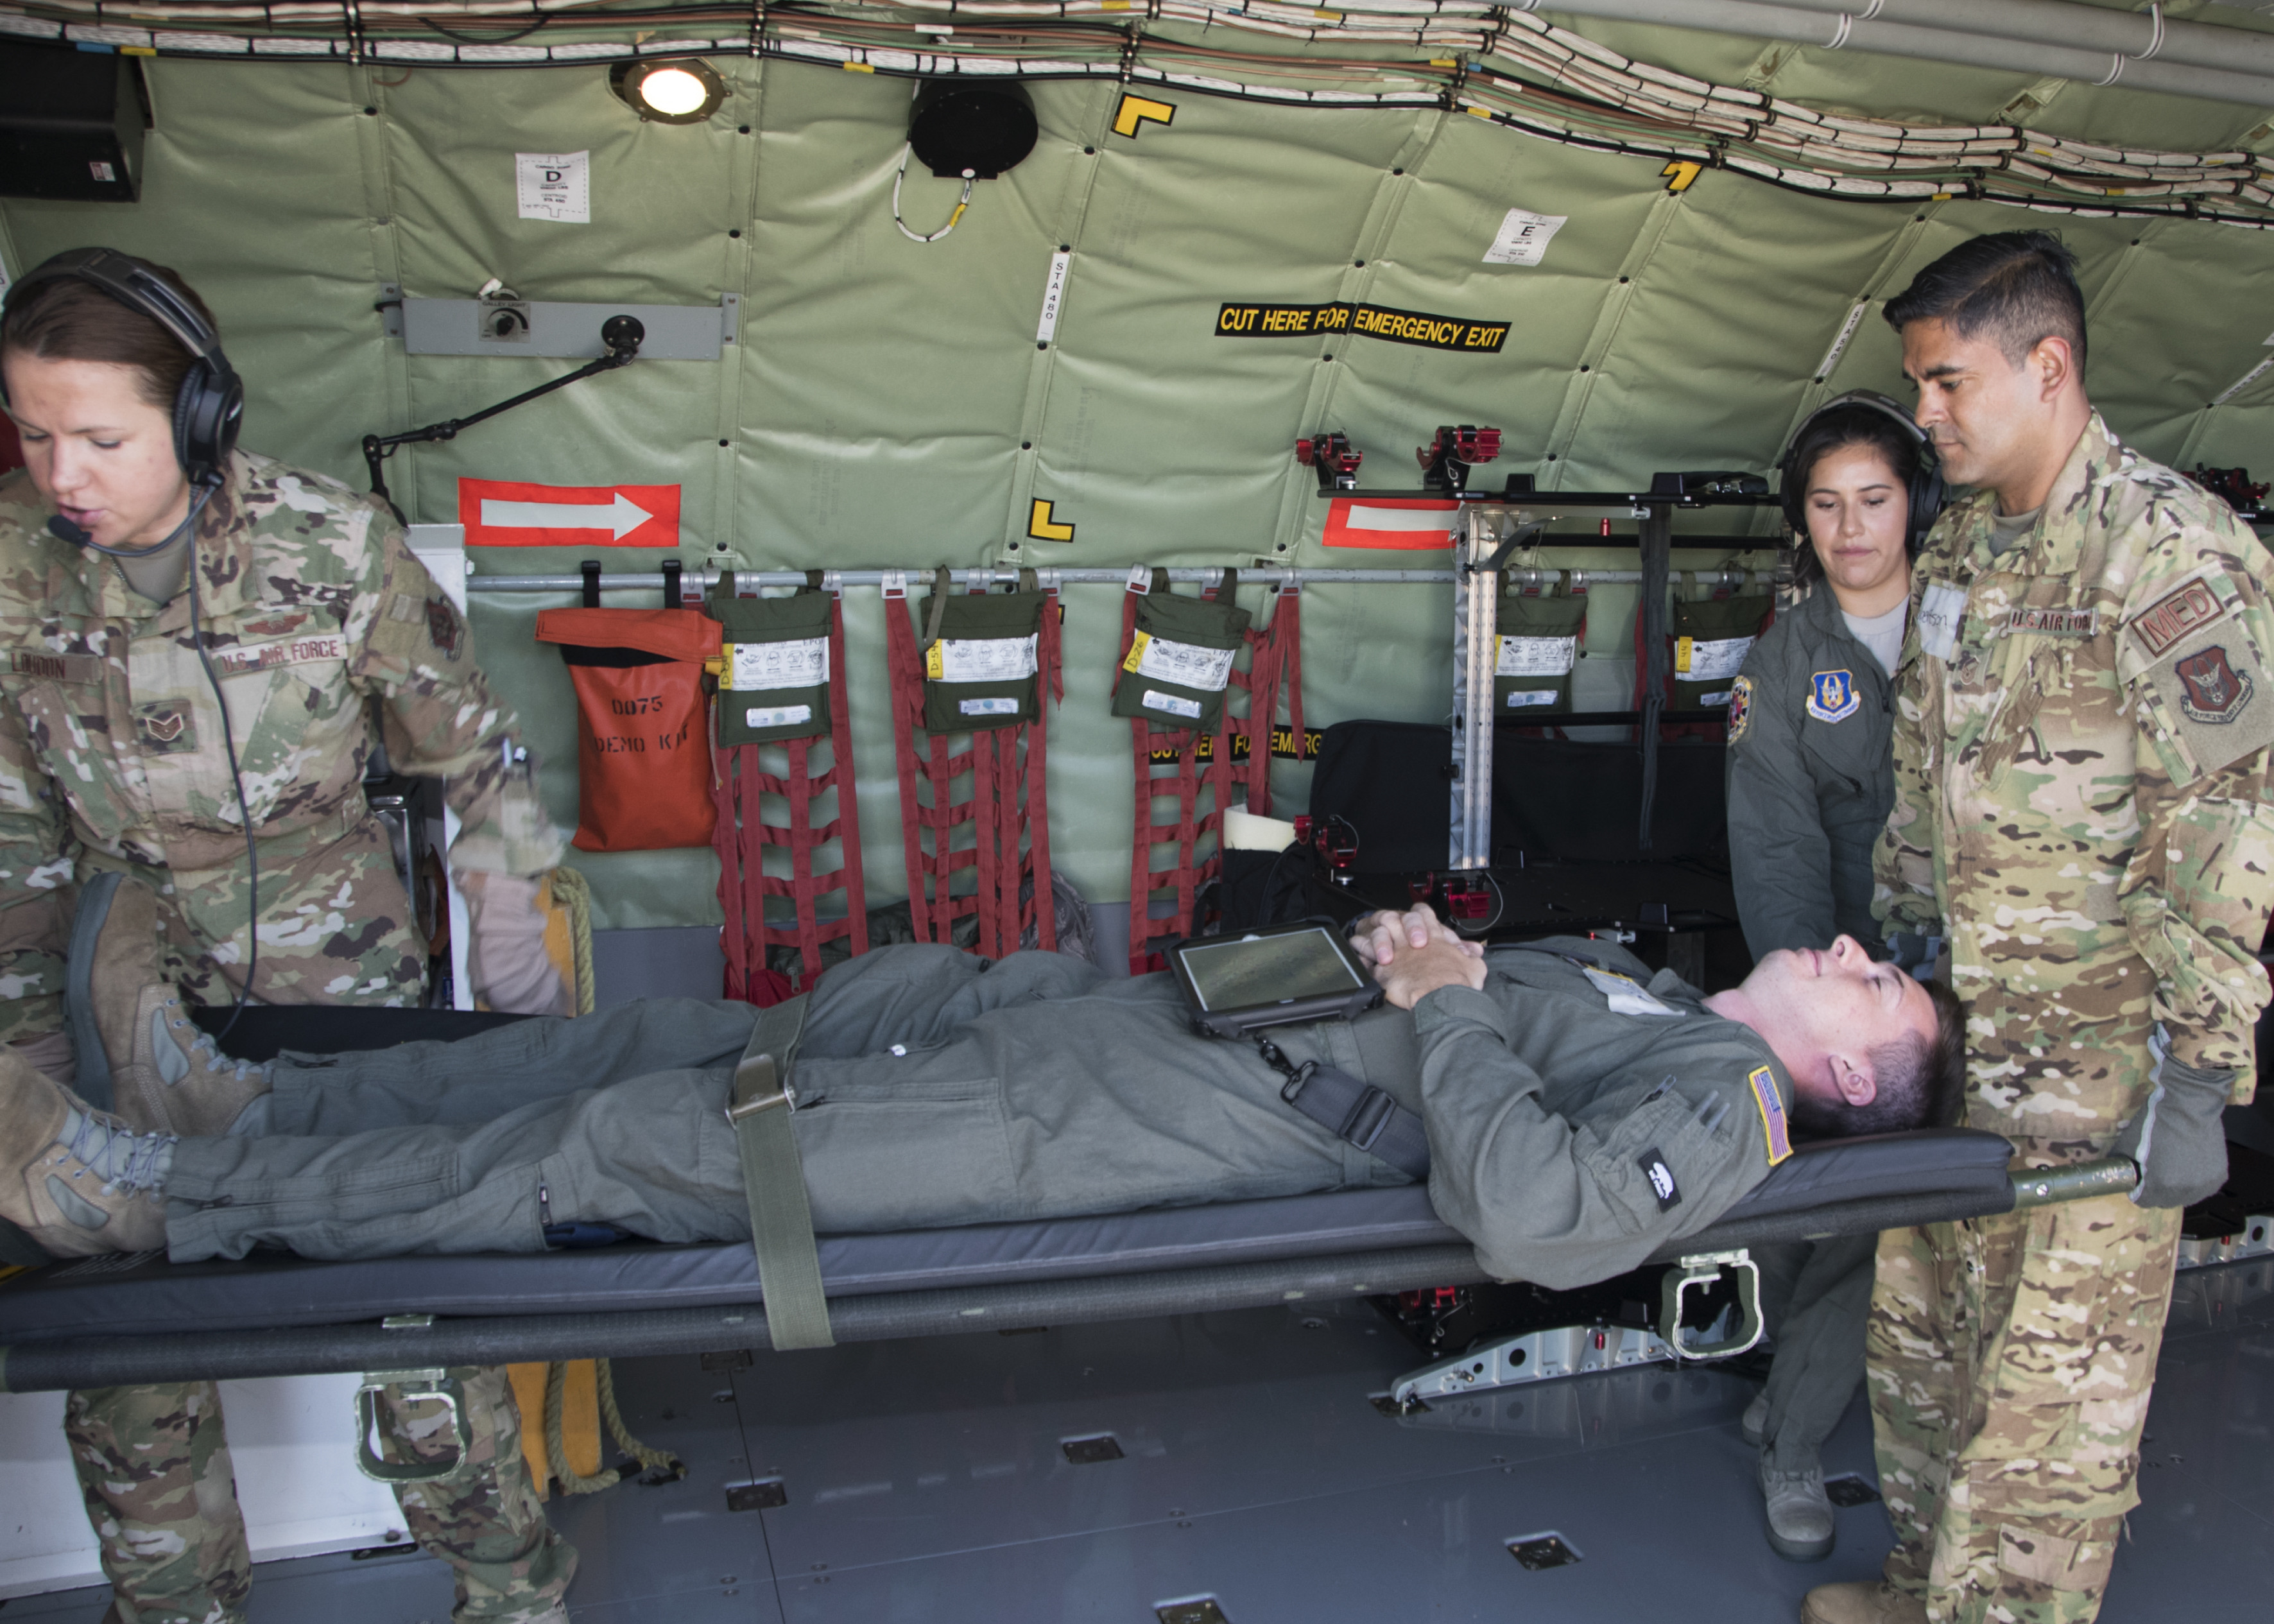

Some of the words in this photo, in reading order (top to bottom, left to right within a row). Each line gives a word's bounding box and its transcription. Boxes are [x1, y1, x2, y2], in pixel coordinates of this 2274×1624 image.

[546, 171, 562, 182] D
[1520, 226, 1536, 236] E
[1051, 263, 1064, 290] STA
[1046, 295, 1056, 320] 480
[1221, 308, 1259, 331] CUT
[1262, 310, 1311, 331] HERE
[1313, 307, 1349, 330] FOR
[1354, 309, 1464, 345] EMERGENCY
[1465, 327, 1505, 347] EXIT
[1844, 311, 1859, 334] STA
[1830, 338, 1846, 359] 540
[2038, 614, 2063, 631] AIR
[2142, 589, 2210, 648] MED
[222, 653, 252, 673] U.S.
[259, 645, 285, 666] AIR
[291, 639, 339, 661] FORCE
[931, 645, 940, 671] D-54
[612, 695, 663, 715] 0075
[594, 736, 645, 753] DEMO
[659, 723, 687, 750] KIT
